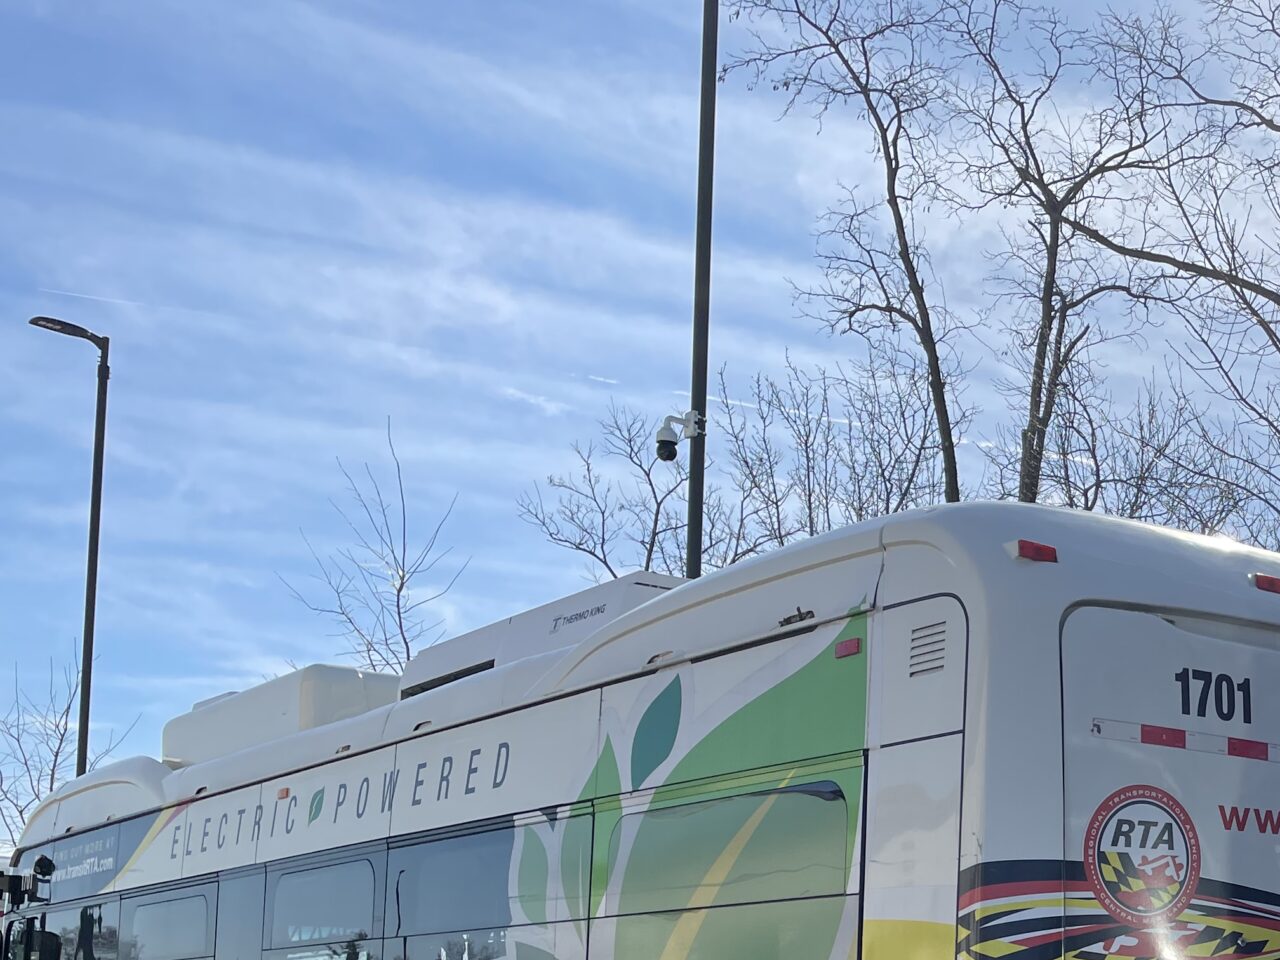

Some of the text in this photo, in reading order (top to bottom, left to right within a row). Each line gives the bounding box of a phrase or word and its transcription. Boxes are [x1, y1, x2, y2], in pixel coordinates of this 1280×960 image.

[589, 603, 607, 616] KING
[1175, 667, 1251, 724] 1701
[170, 742, 511, 860] ELECTRIC POWERED
[1088, 789, 1199, 867] REGIONAL TRANSPORTATION AGENCY
[1111, 818, 1175, 851] RTA
[1100, 892, 1137, 923] CENTRAL
